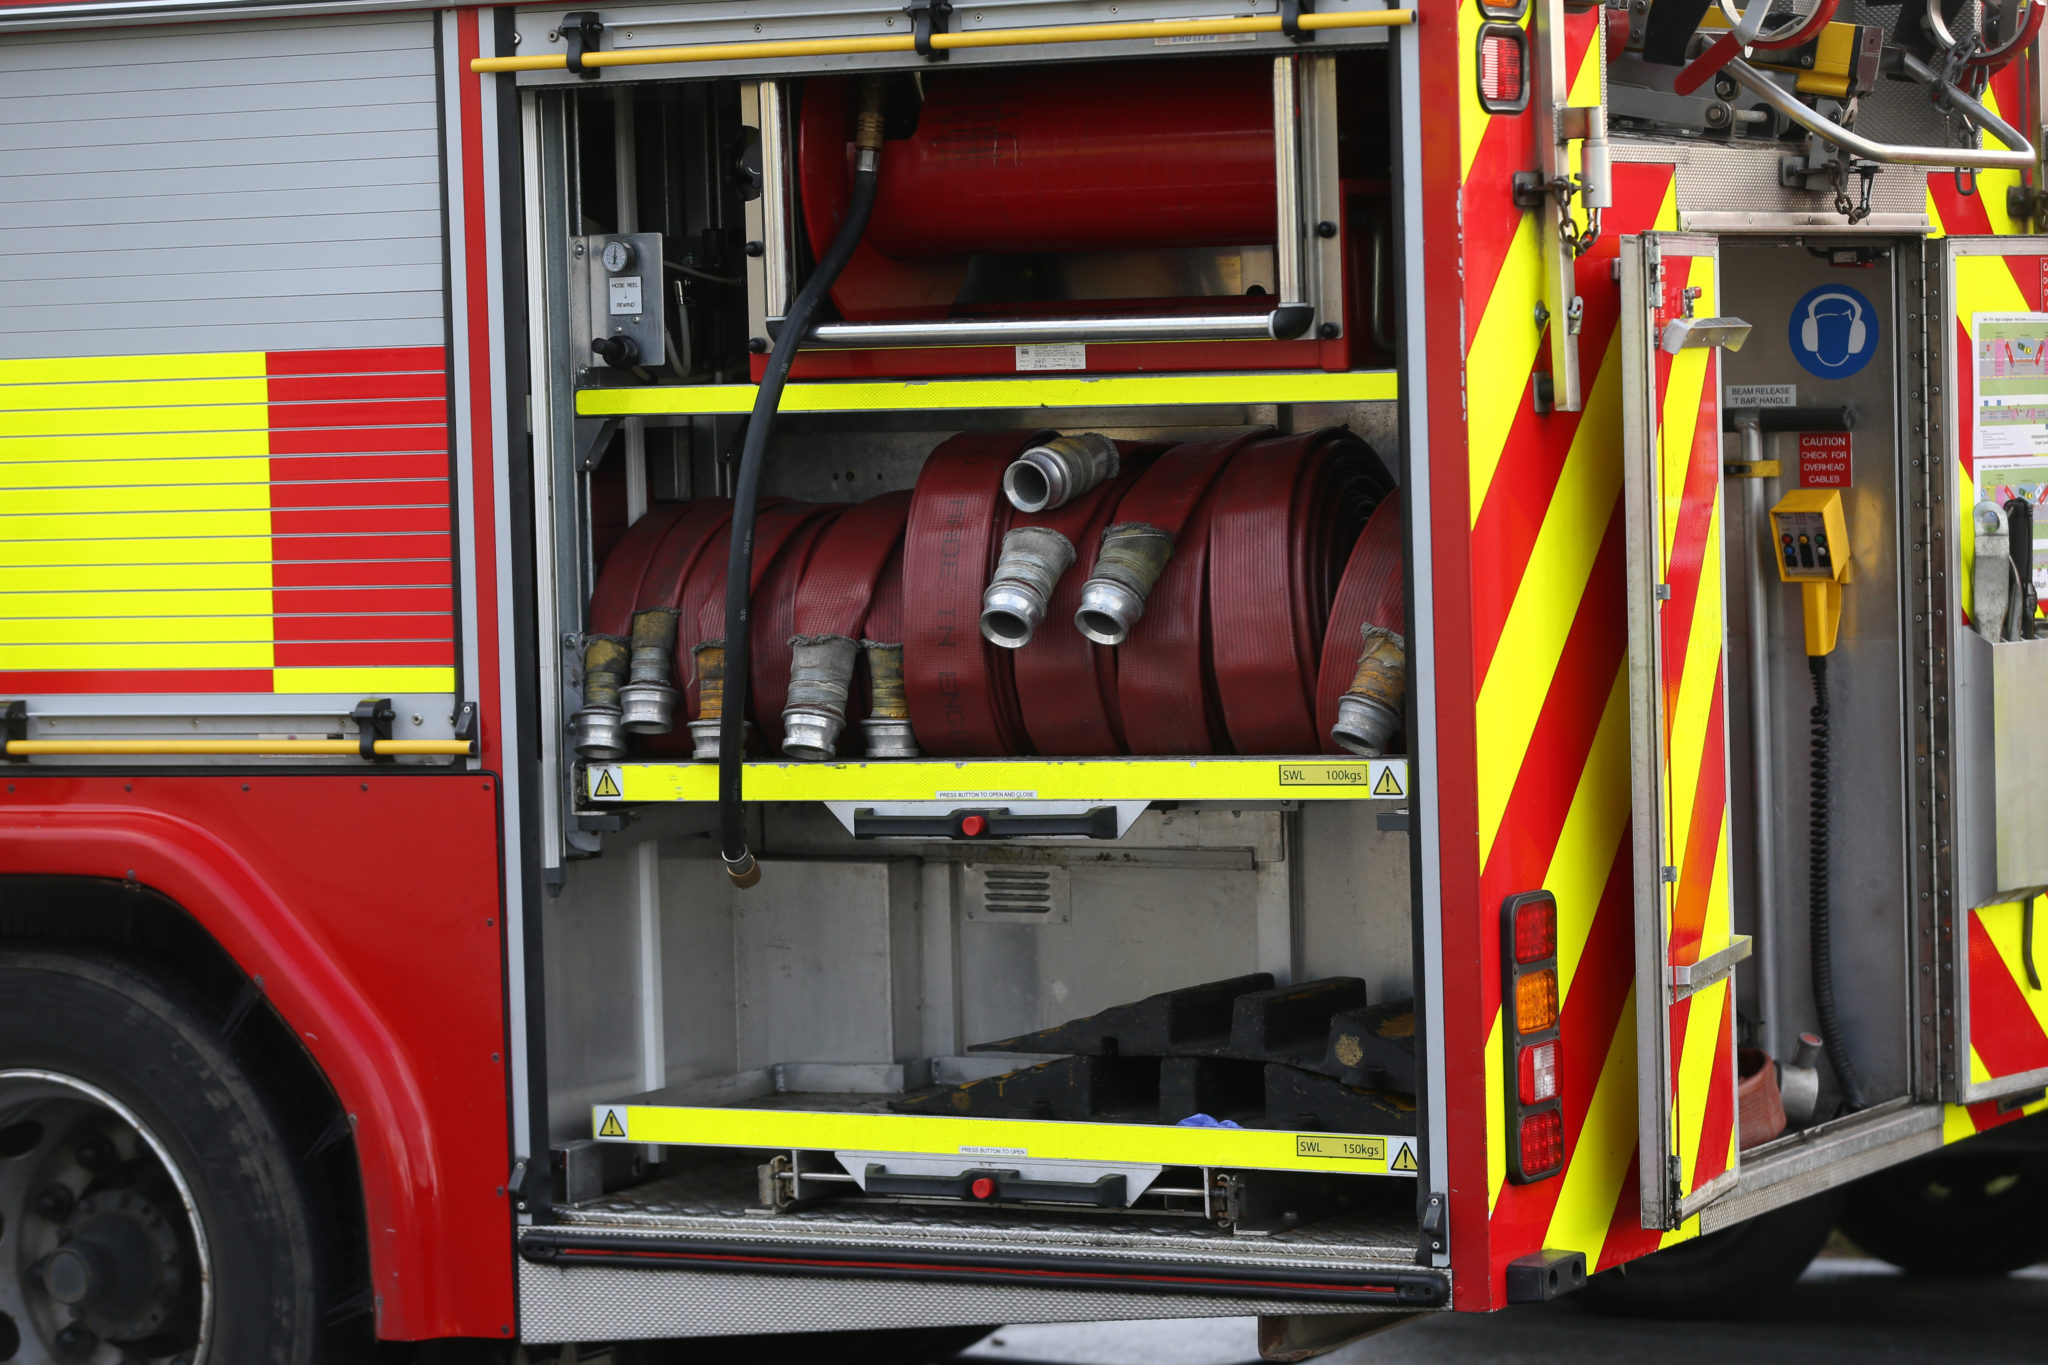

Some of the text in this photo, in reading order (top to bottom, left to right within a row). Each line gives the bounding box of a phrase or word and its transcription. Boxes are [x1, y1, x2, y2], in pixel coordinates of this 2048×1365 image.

[1732, 386, 1791, 395] BEAM RELEASE
[1759, 396, 1791, 405] HANDLE
[1802, 436, 1846, 446] CAUTION
[1801, 450, 1847, 459] CHECK FOR
[1803, 463, 1846, 471] OVERHEAD
[1808, 475, 1840, 483] CABLES
[937, 608, 956, 647] IN
[1283, 769, 1362, 783] SWL 100kgs
[1300, 1141, 1379, 1157] SWL 150kgs
